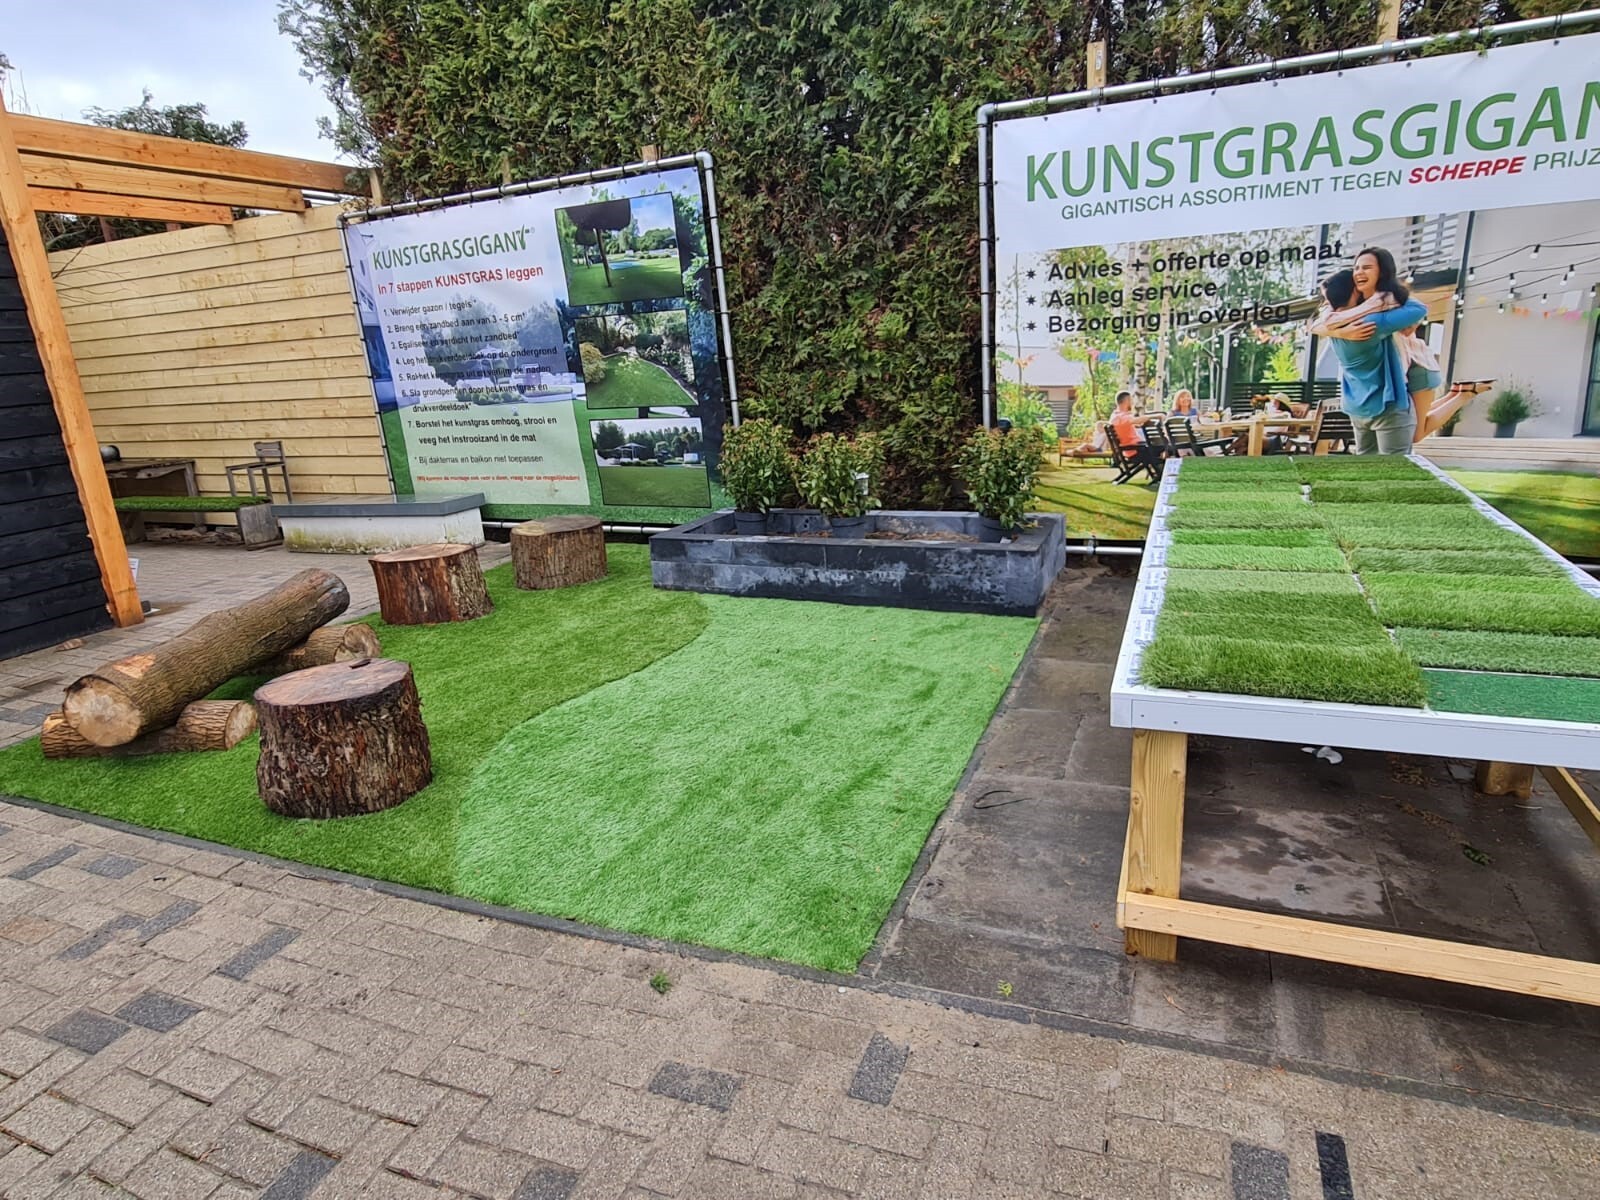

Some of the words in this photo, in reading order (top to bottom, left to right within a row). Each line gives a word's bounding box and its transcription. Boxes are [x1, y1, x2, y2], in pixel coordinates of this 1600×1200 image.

[1061, 192, 1174, 220] GIGANTISCH
[1179, 178, 1324, 208] ASSORTIMENT
[1330, 169, 1402, 192] TEGEN
[1408, 156, 1526, 184] SCHERPE
[1048, 260, 1123, 282] Advies
[1131, 258, 1145, 272] +
[1153, 250, 1231, 273] offerte
[1239, 249, 1270, 270] op
[1279, 240, 1343, 262] maat
[378, 284, 387, 295] In
[389, 282, 394, 293] 7
[397, 278, 433, 293] stappen
[435, 268, 503, 287] KUNSTGRAS
[505, 266, 544, 282] leggen
[1048, 286, 1123, 308] Aanleg
[1131, 280, 1218, 302] service
[390, 305, 420, 316] Verwijder
[422, 304, 443, 315] gazon
[1048, 311, 1161, 334] Bezorging
[1169, 308, 1189, 326] in
[1199, 301, 1290, 325] overleg
[395, 324, 414, 333] Breng
[430, 318, 459, 329] zandbed
[462, 319, 475, 327] aan
[478, 317, 491, 325] van
[492, 314, 497, 323] 3
[504, 313, 509, 322] 5
[415, 420, 440, 428] Borstel
[442, 419, 453, 427] het
[455, 418, 489, 428] kunstgras
[523, 417, 545, 425] strooi
[419, 437, 437, 446] veeg
[438, 435, 451, 444] het
[452, 434, 499, 443] instrooizand
[501, 434, 509, 442] in
[510, 433, 520, 442] de
[521, 433, 537, 442] mat
[508, 455, 544, 464] toepassen
